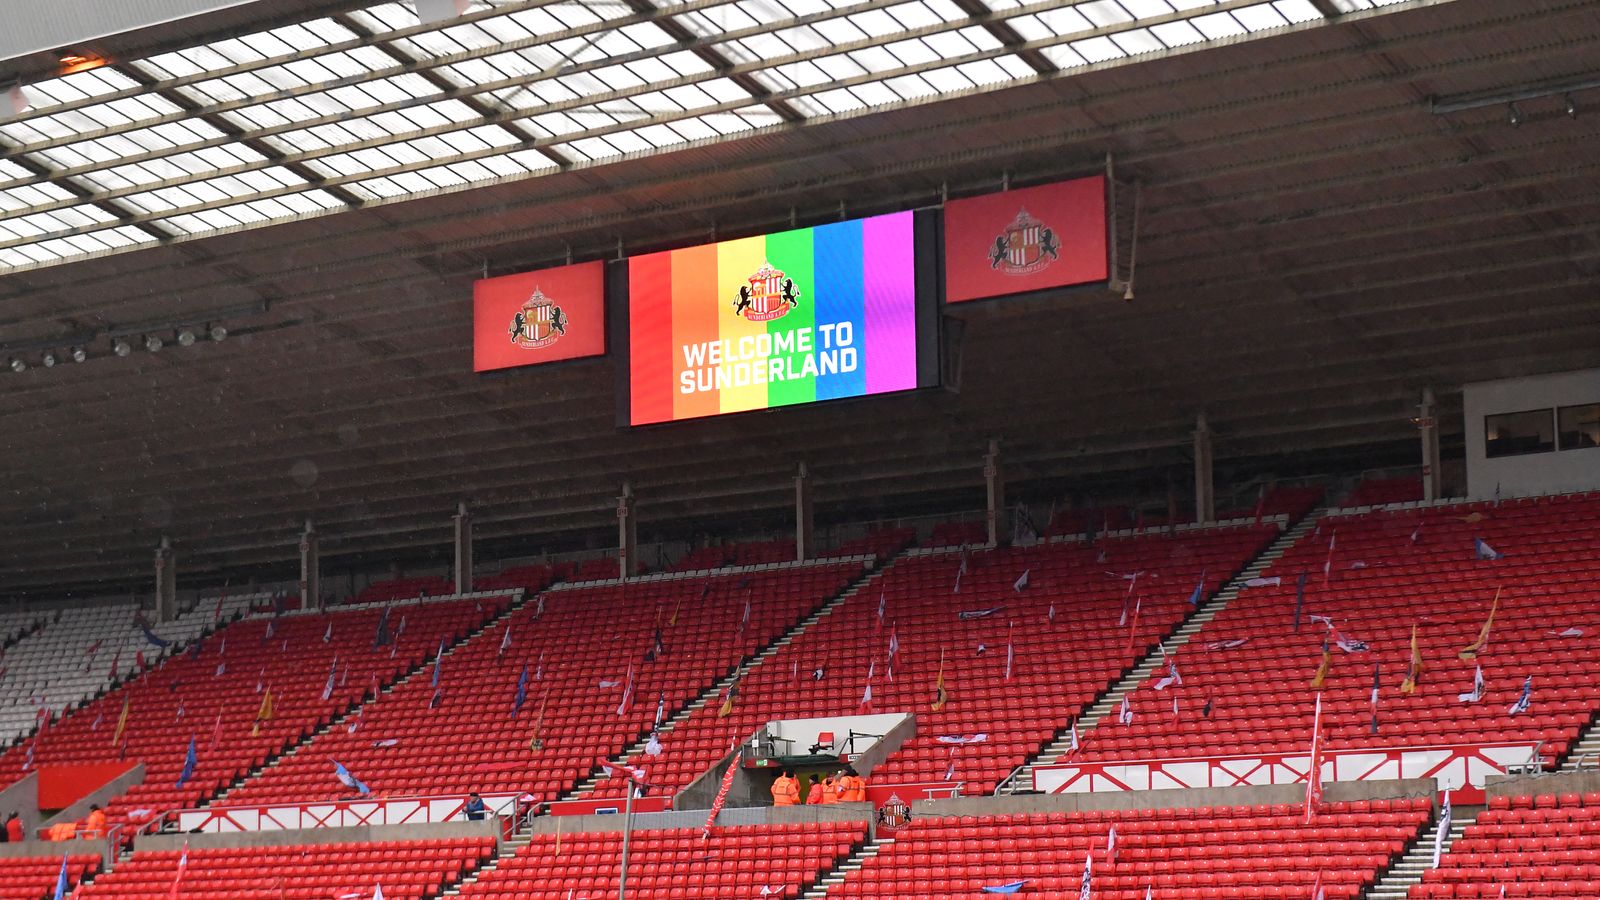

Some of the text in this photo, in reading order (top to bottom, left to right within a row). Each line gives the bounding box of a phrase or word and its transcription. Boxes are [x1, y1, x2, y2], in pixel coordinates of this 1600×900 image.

[683, 321, 853, 368] WELCOME TO
[680, 347, 857, 394] SUNDERLAND
